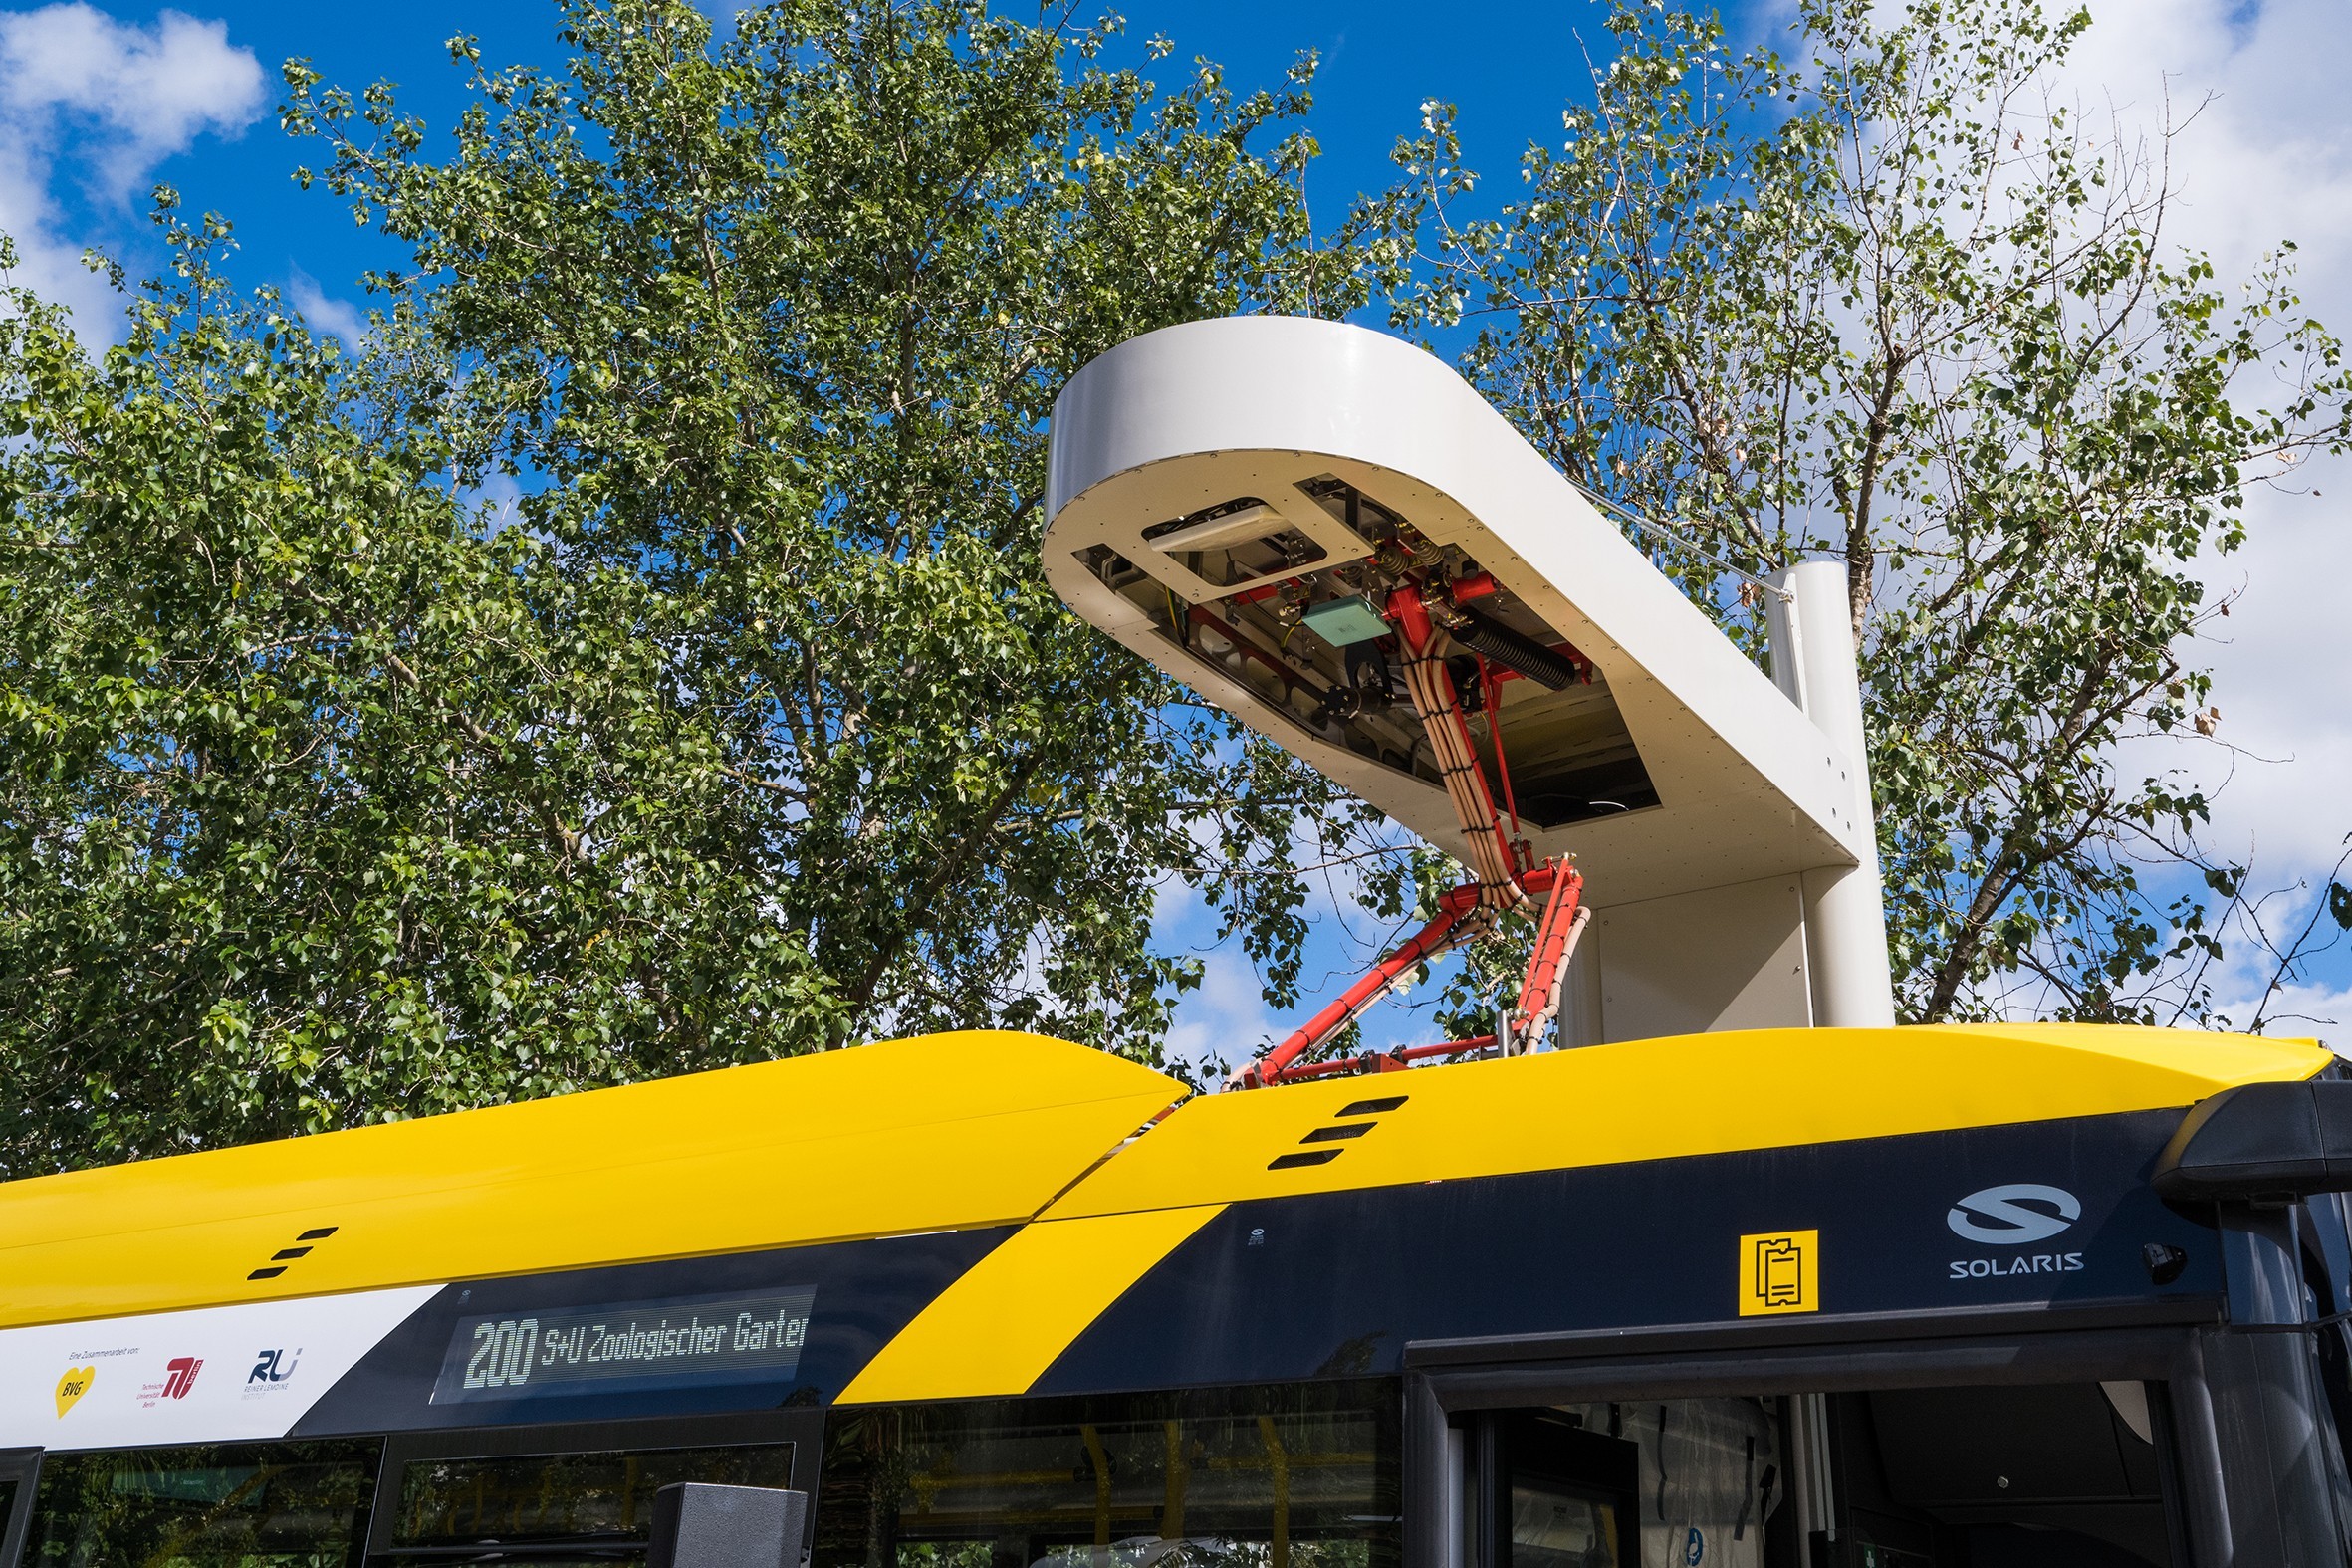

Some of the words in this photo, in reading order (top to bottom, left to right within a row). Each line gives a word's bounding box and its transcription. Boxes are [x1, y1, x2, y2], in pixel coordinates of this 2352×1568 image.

[1949, 1252, 2085, 1279] SOLARIS
[463, 1318, 539, 1389] 200
[541, 1326, 586, 1366] S+U
[587, 1317, 728, 1362] Zoologischer
[62, 1381, 84, 1397] BVG
